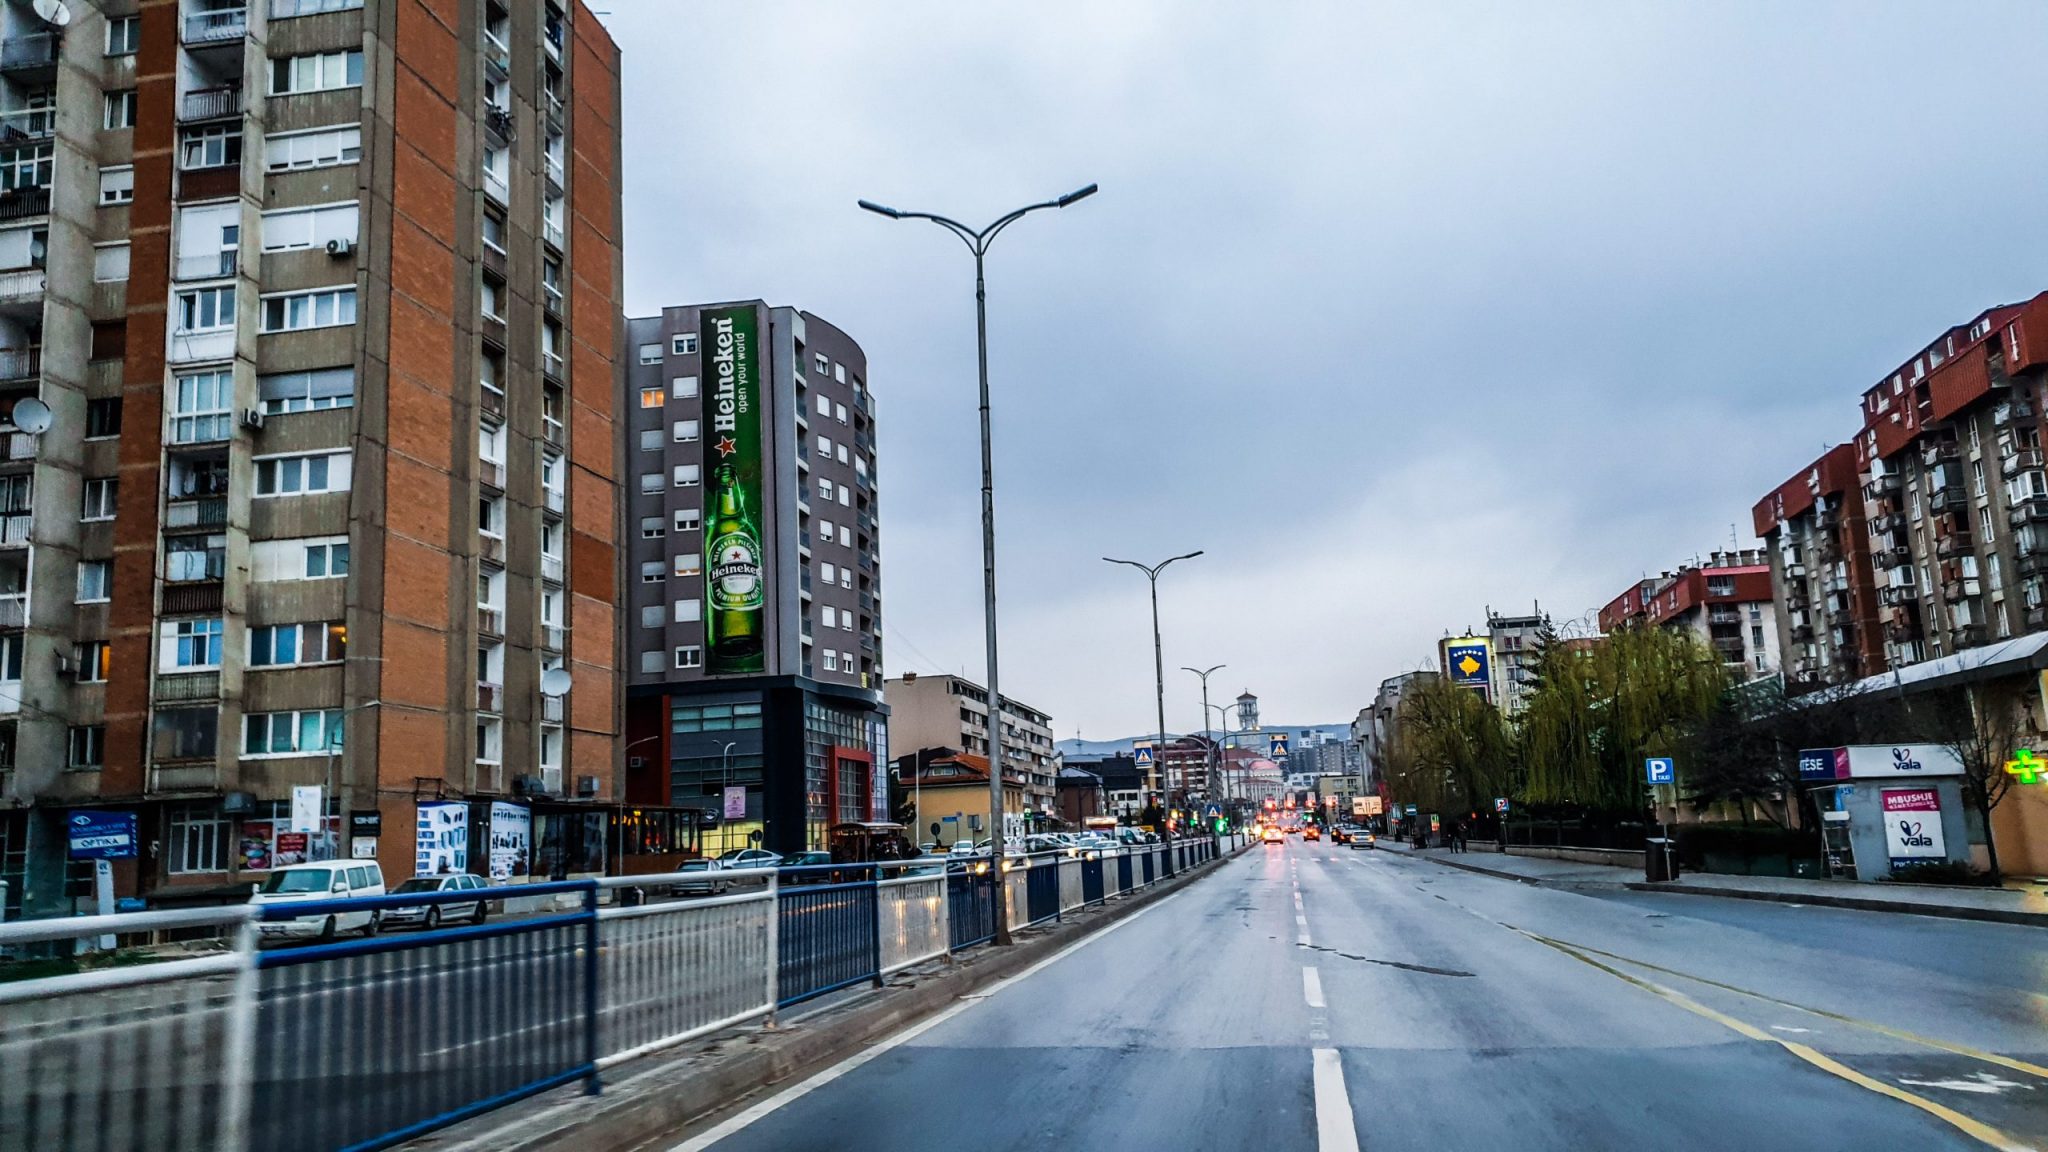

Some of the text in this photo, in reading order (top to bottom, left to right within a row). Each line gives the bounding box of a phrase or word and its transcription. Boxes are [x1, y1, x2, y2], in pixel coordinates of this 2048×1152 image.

[713, 317, 736, 432] Heineken
[734, 333, 749, 413] open your world
[1651, 761, 1666, 780] P
[1893, 759, 1922, 770] vala
[1887, 792, 1933, 805] MBUSHJE
[80, 838, 119, 848] OPTIKA
[1901, 834, 1933, 847] vala
